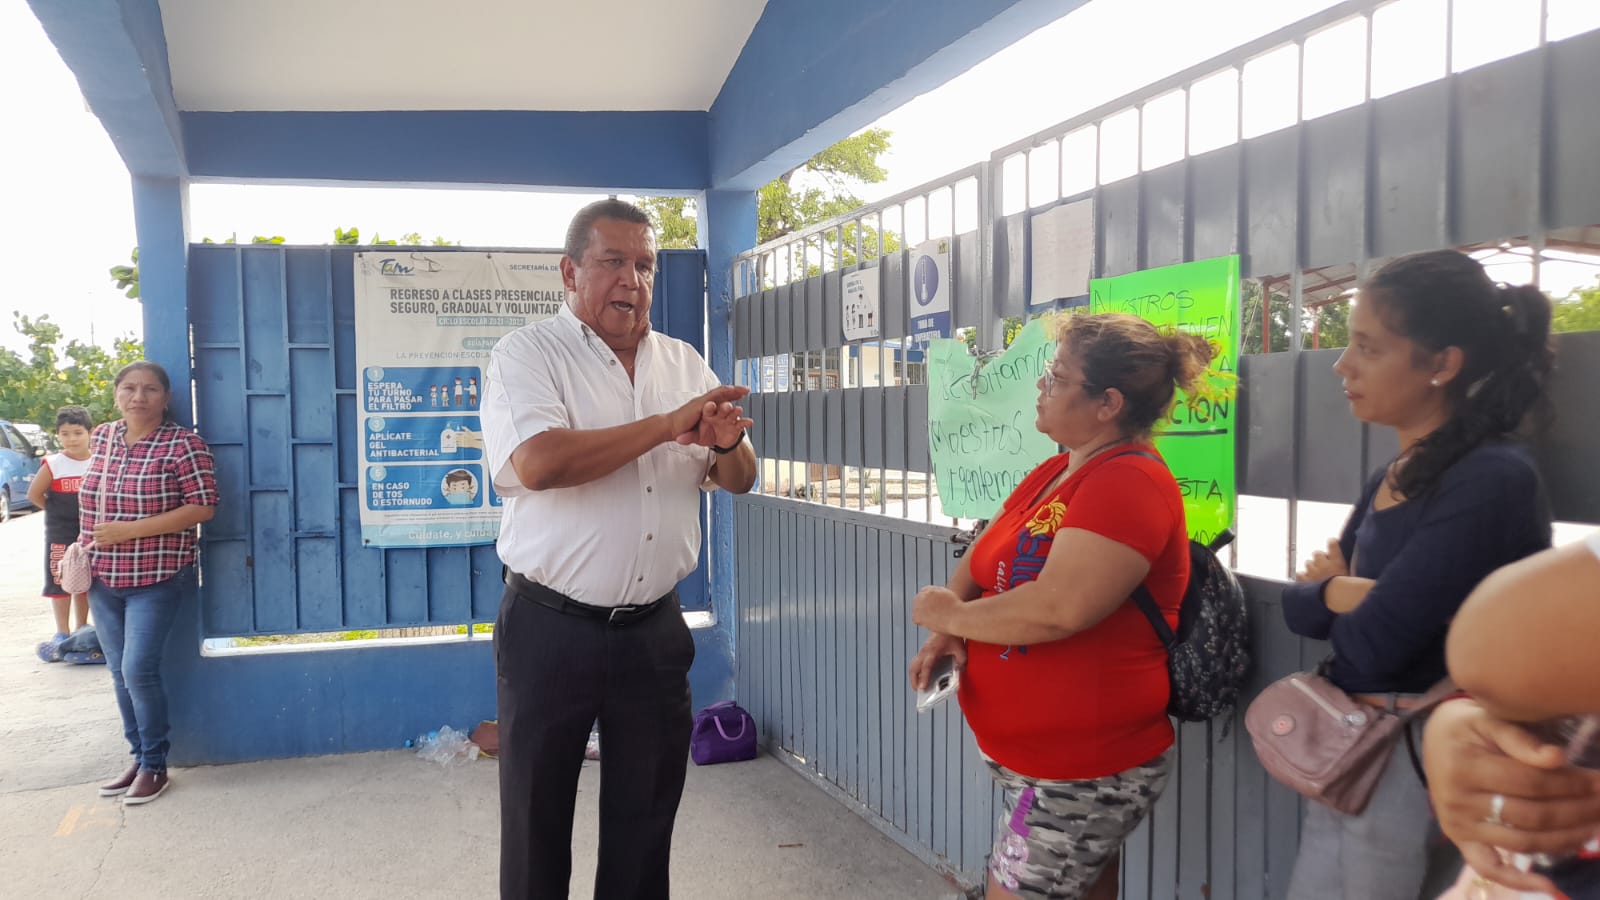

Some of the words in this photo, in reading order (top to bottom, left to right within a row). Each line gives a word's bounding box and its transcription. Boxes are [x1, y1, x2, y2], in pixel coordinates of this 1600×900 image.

[390, 288, 440, 301] REGRESO
[442, 289, 450, 301] A
[452, 289, 492, 301] CLASES
[494, 289, 566, 302] PRESENCIALE
[390, 302, 439, 315] SEGURO,
[441, 302, 493, 314] GRADUAL
[495, 302, 502, 314] Y
[461, 351, 490, 360] ESCOLA
[368, 382, 403, 391] ESPERA
[368, 389, 380, 397] TU
[382, 389, 412, 397] TURNO
[394, 395, 423, 403] PASAR
[381, 402, 412, 410] FILTRO
[369, 430, 412, 441] APLÍCATE
[369, 441, 386, 449] GEL
[370, 448, 440, 457] ANTIBACTERIAL
[371, 482, 384, 491] EN
[386, 481, 410, 490] CASO
[372, 491, 384, 499] DE
[386, 490, 403, 498] TOS
[373, 498, 379, 506] O
[380, 498, 433, 506] ESTORNUDO
